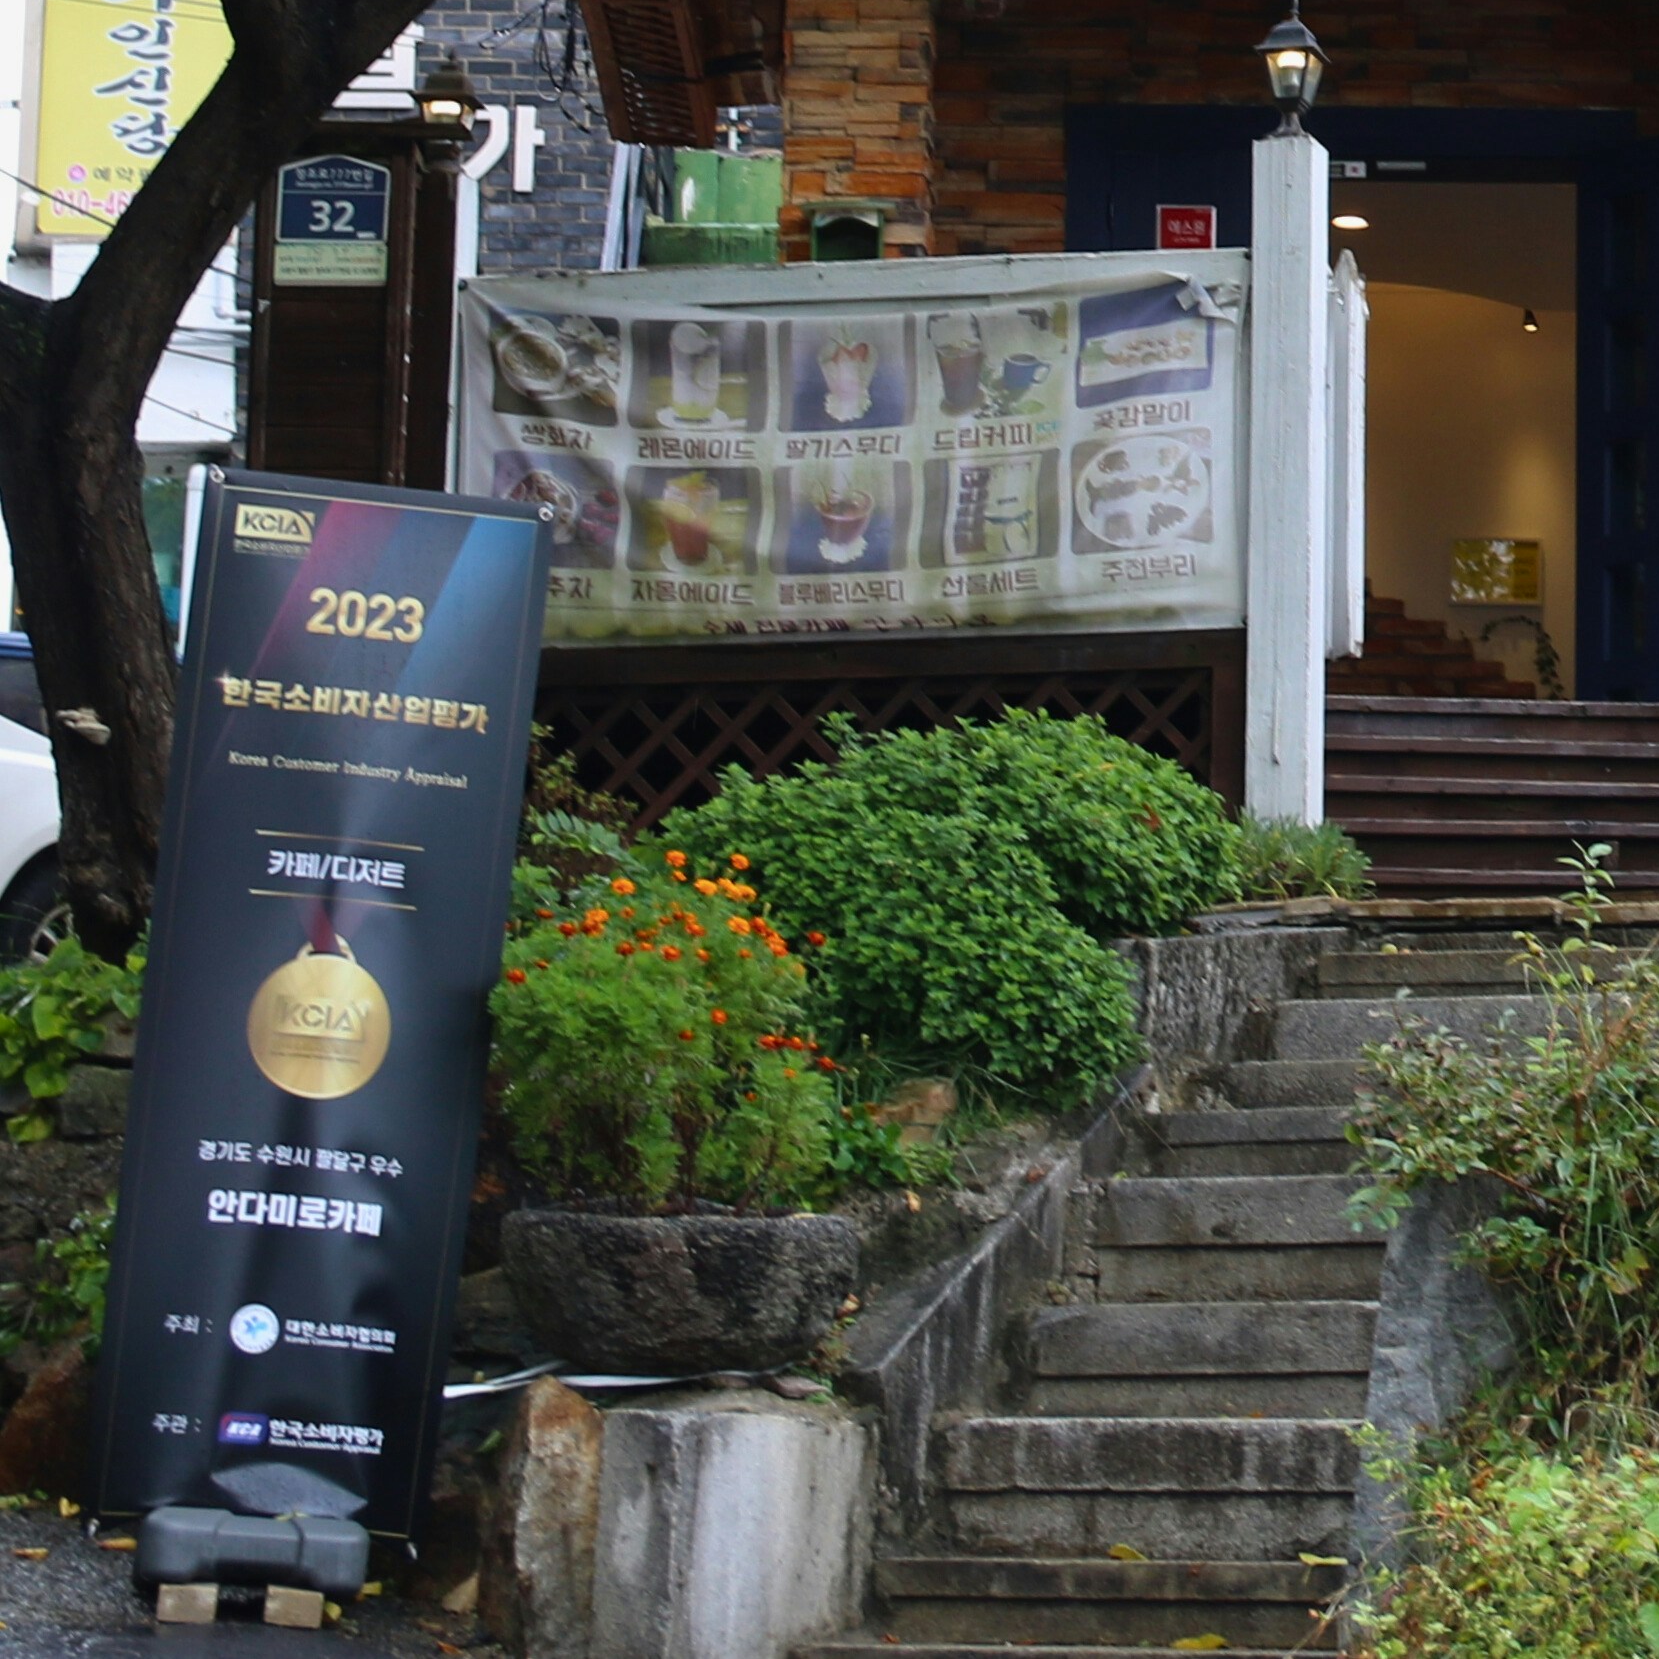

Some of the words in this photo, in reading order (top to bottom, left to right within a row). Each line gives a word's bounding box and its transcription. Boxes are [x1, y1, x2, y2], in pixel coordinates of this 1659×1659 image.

[308, 200, 356, 232] 32
[521, 422, 592, 450] 쌍화차
[638, 436, 755, 459] 레몬에이드
[786, 434, 900, 459] 딸기스무디
[933, 422, 1032, 451] 드립커피
[241, 511, 302, 535] KCIA
[1102, 554, 1196, 582] 주전부리
[632, 578, 754, 604] 자몽에이드
[779, 579, 904, 605] 블루베리스무디
[942, 568, 1039, 598] 선물세트
[306, 587, 424, 643] 2023
[222, 677, 489, 734] 한국소비자산업평가
[229, 750, 269, 767] Korea
[273, 755, 340, 774] Customer
[404, 766, 468, 789] Appraisal
[267, 850, 405, 888] 카페/디저트
[199, 1139, 252, 1162] 경기도
[257, 1144, 310, 1168] 수원시
[370, 1154, 403, 1178] 우수
[208, 1189, 382, 1237] 안다미로카페
